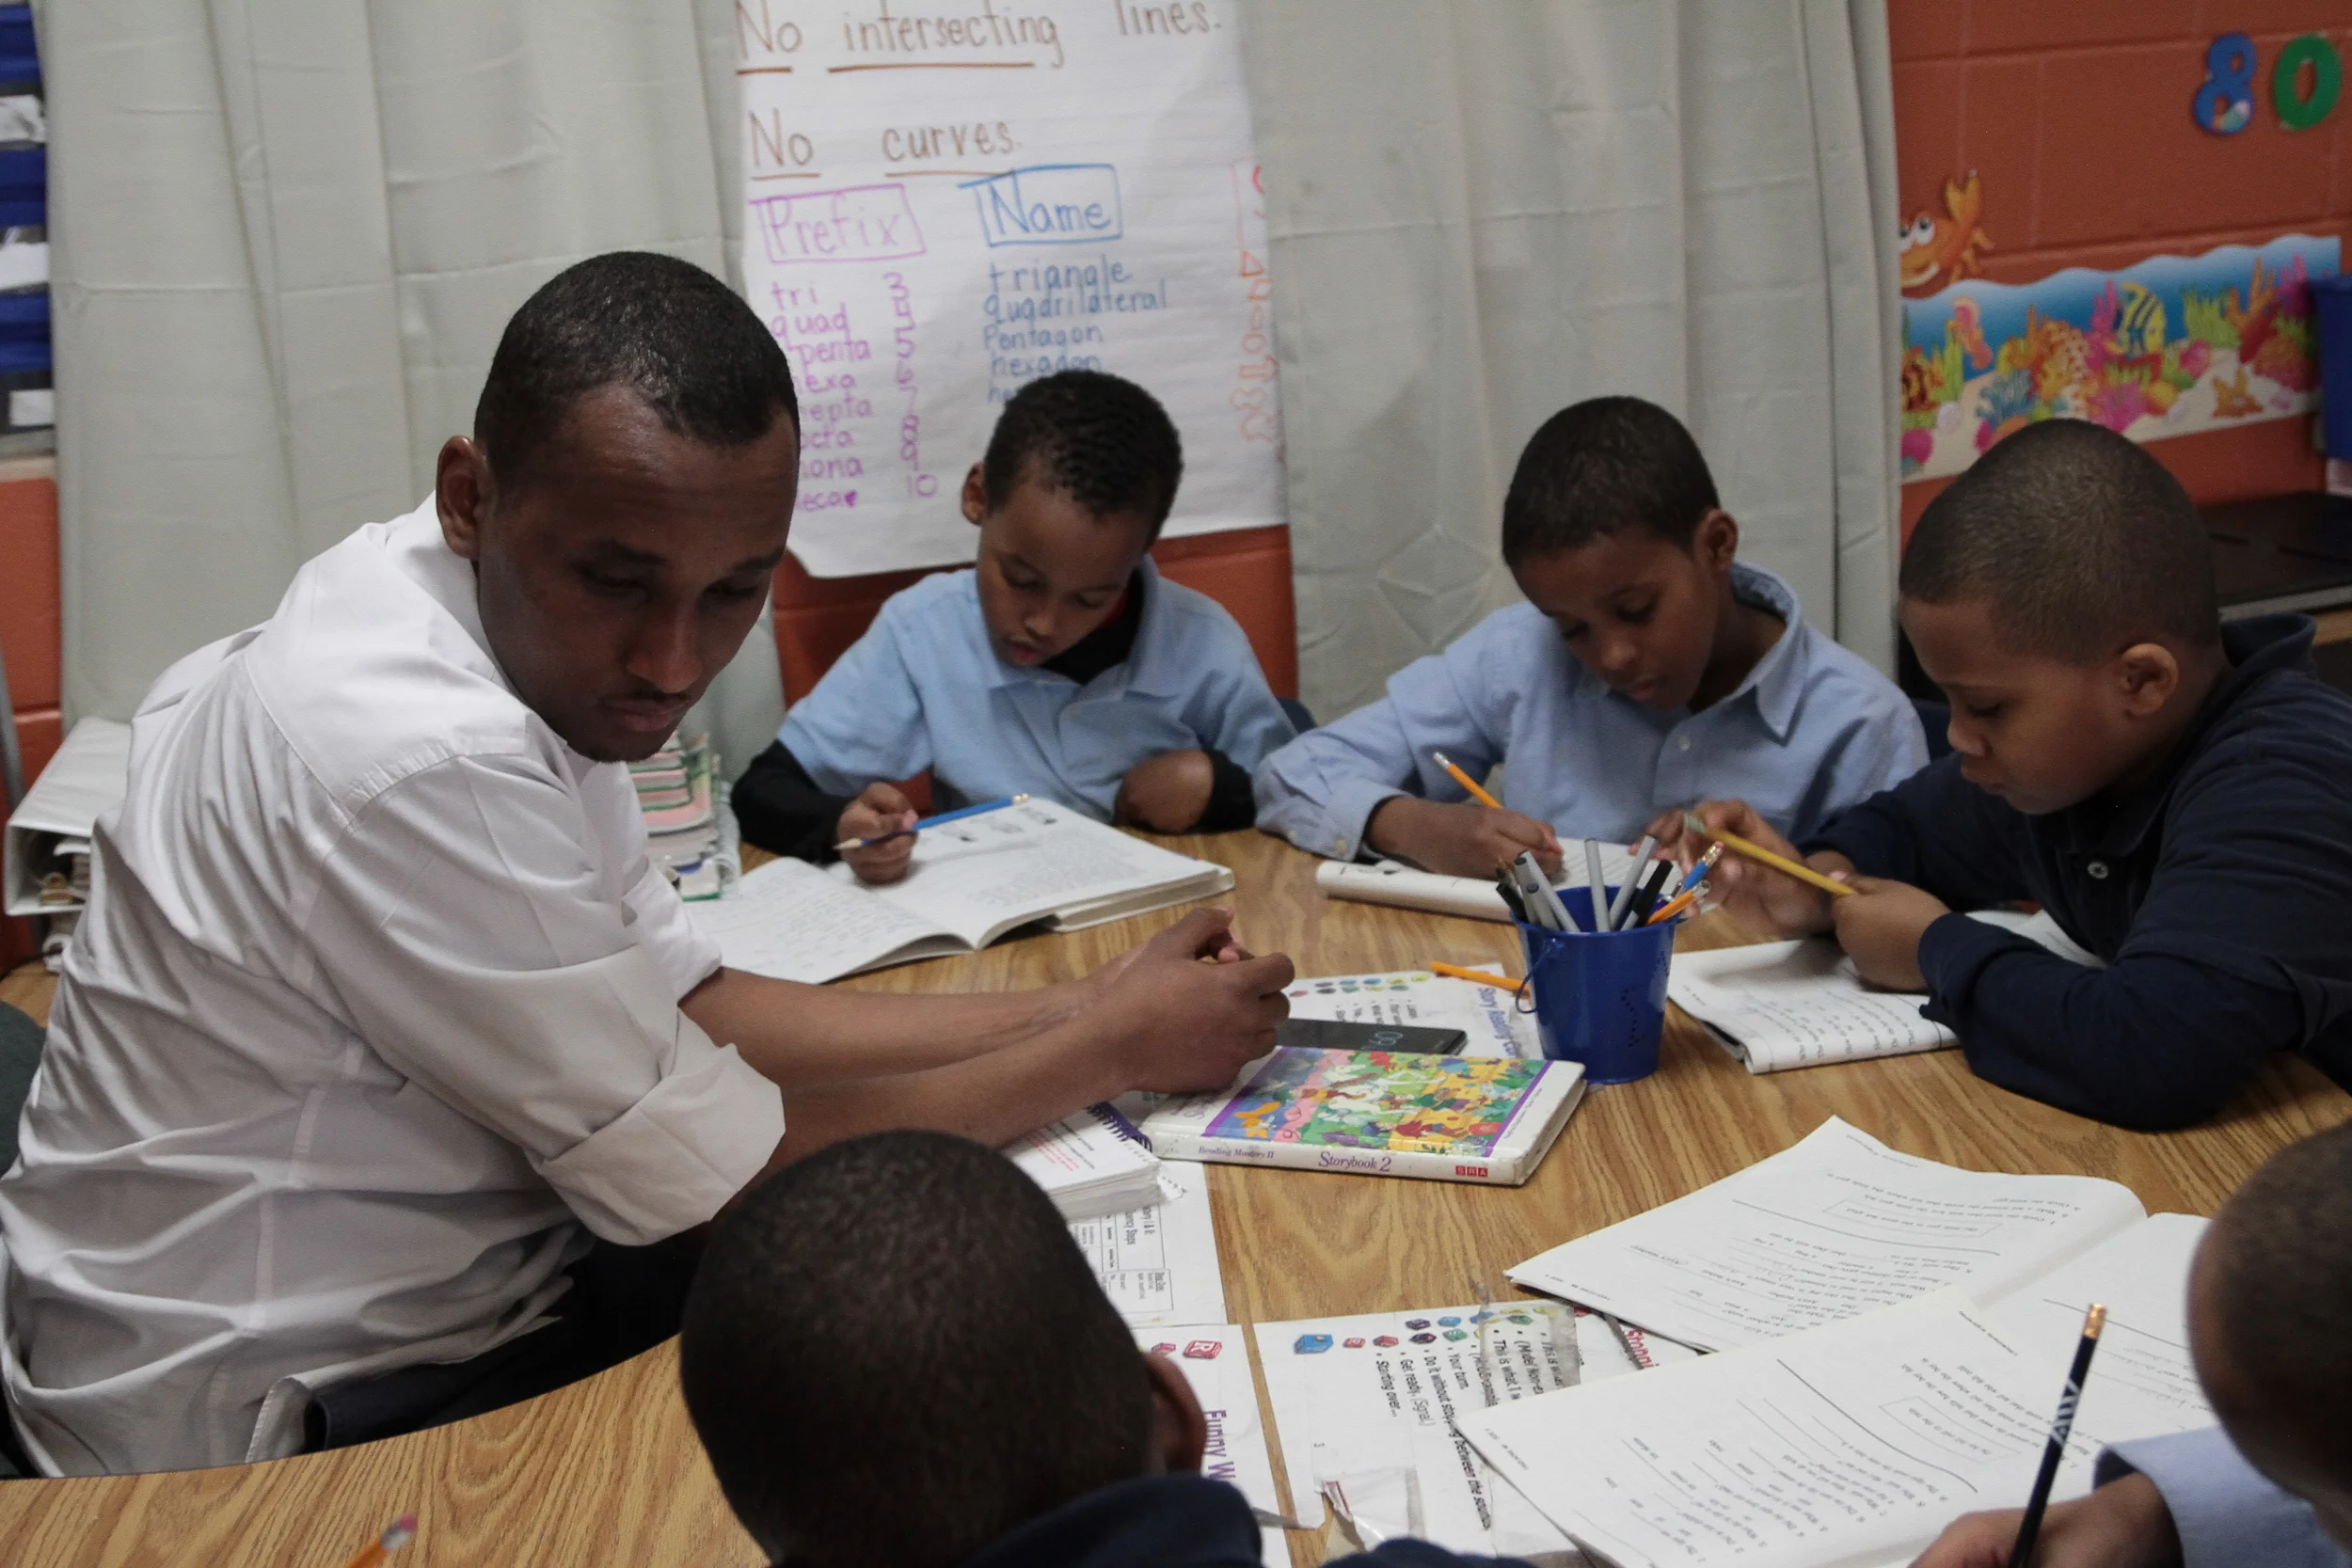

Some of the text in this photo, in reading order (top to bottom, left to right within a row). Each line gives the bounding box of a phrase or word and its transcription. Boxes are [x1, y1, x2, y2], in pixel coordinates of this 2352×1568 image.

[736, 0, 802, 59] No
[845, 2, 1065, 69] intersecting
[749, 108, 1022, 167] No curves.
[763, 175, 1111, 256] Prefix Name
[771, 272, 910, 310] tri 3
[990, 254, 1134, 294] triangle
[982, 277, 1168, 325] quadrilateral
[771, 302, 850, 352] quad
[800, 328, 916, 374] penta 5
[906, 473, 937, 498] 10
[1199, 1145, 1232, 1158] Reading
[1318, 1151, 1392, 1173] Storybook 2
[1375, 1360, 1395, 1390] Starting
[1400, 1359, 1414, 1372] Get
[1424, 1355, 1438, 1367] Do
[1202, 1409, 1228, 1457] Funny
